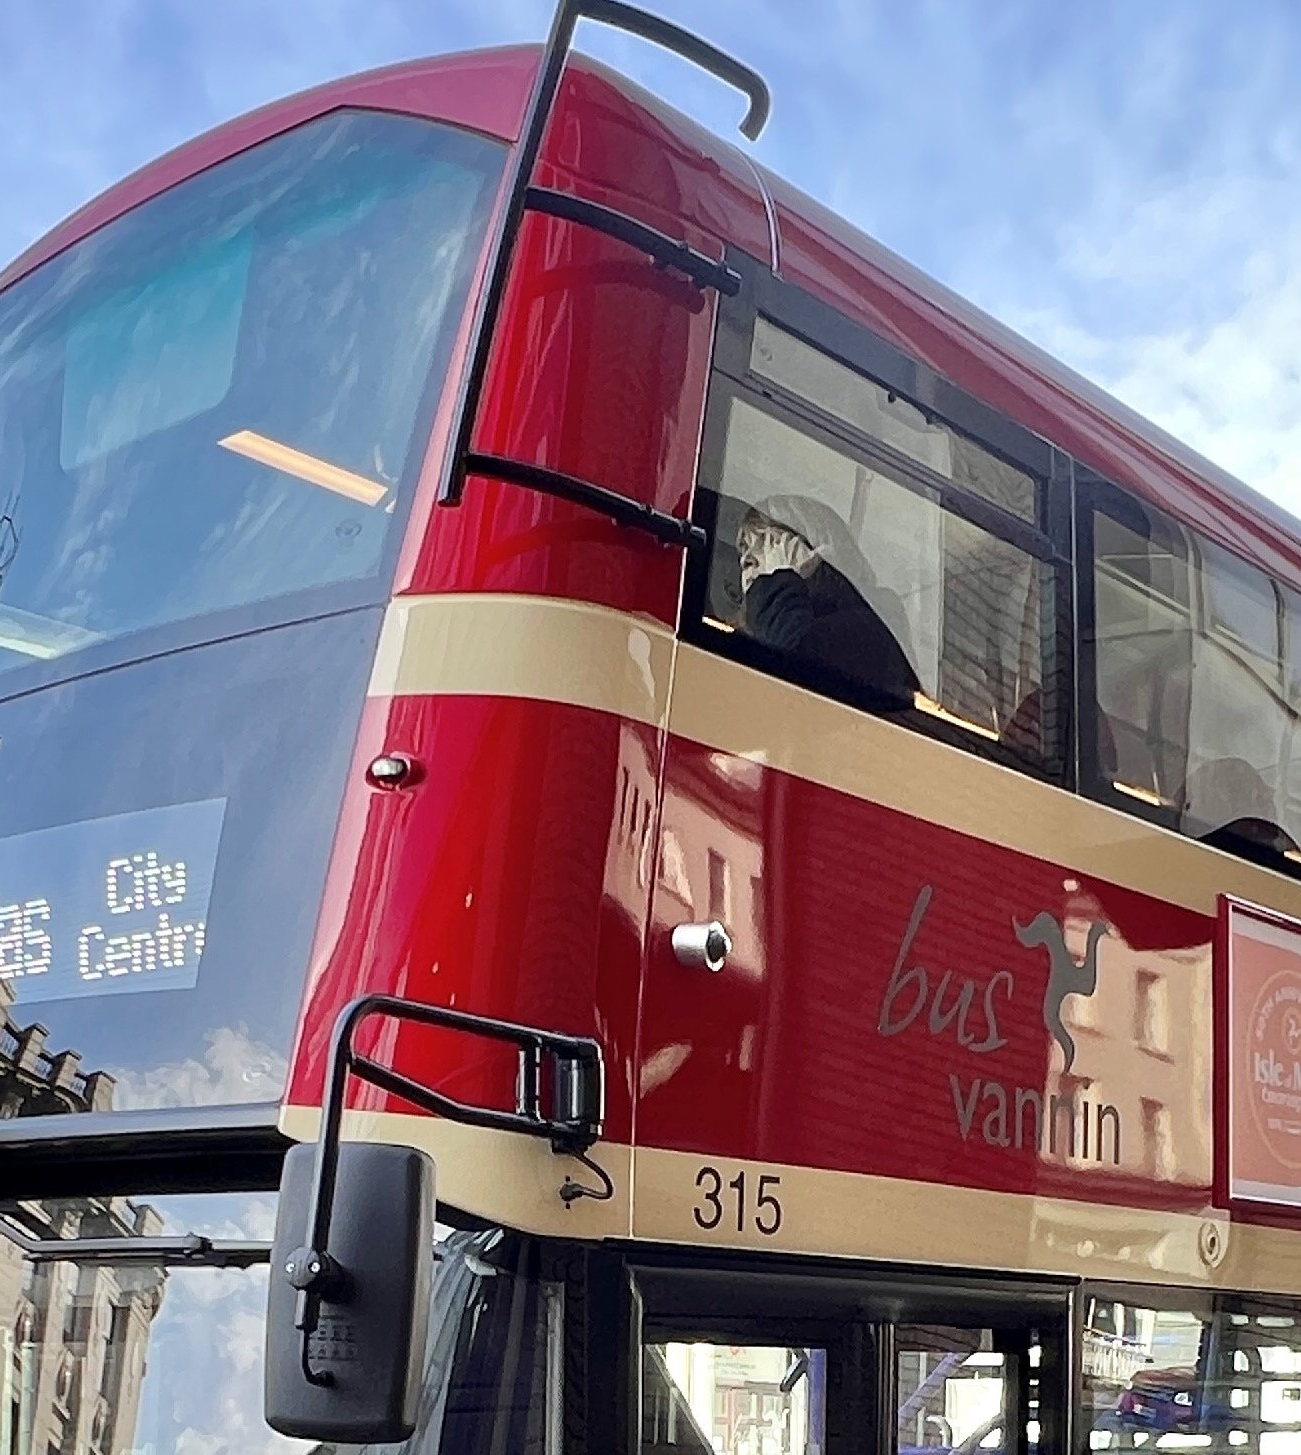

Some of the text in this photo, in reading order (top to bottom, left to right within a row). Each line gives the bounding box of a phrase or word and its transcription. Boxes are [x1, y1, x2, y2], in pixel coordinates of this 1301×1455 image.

[106, 852, 187, 914] City
[78, 912, 205, 980] Centr
[877, 884, 1014, 1052] bus
[1253, 1048, 1285, 1087] Isle
[948, 1071, 1122, 1166] vannin
[692, 1166, 782, 1236] 315
